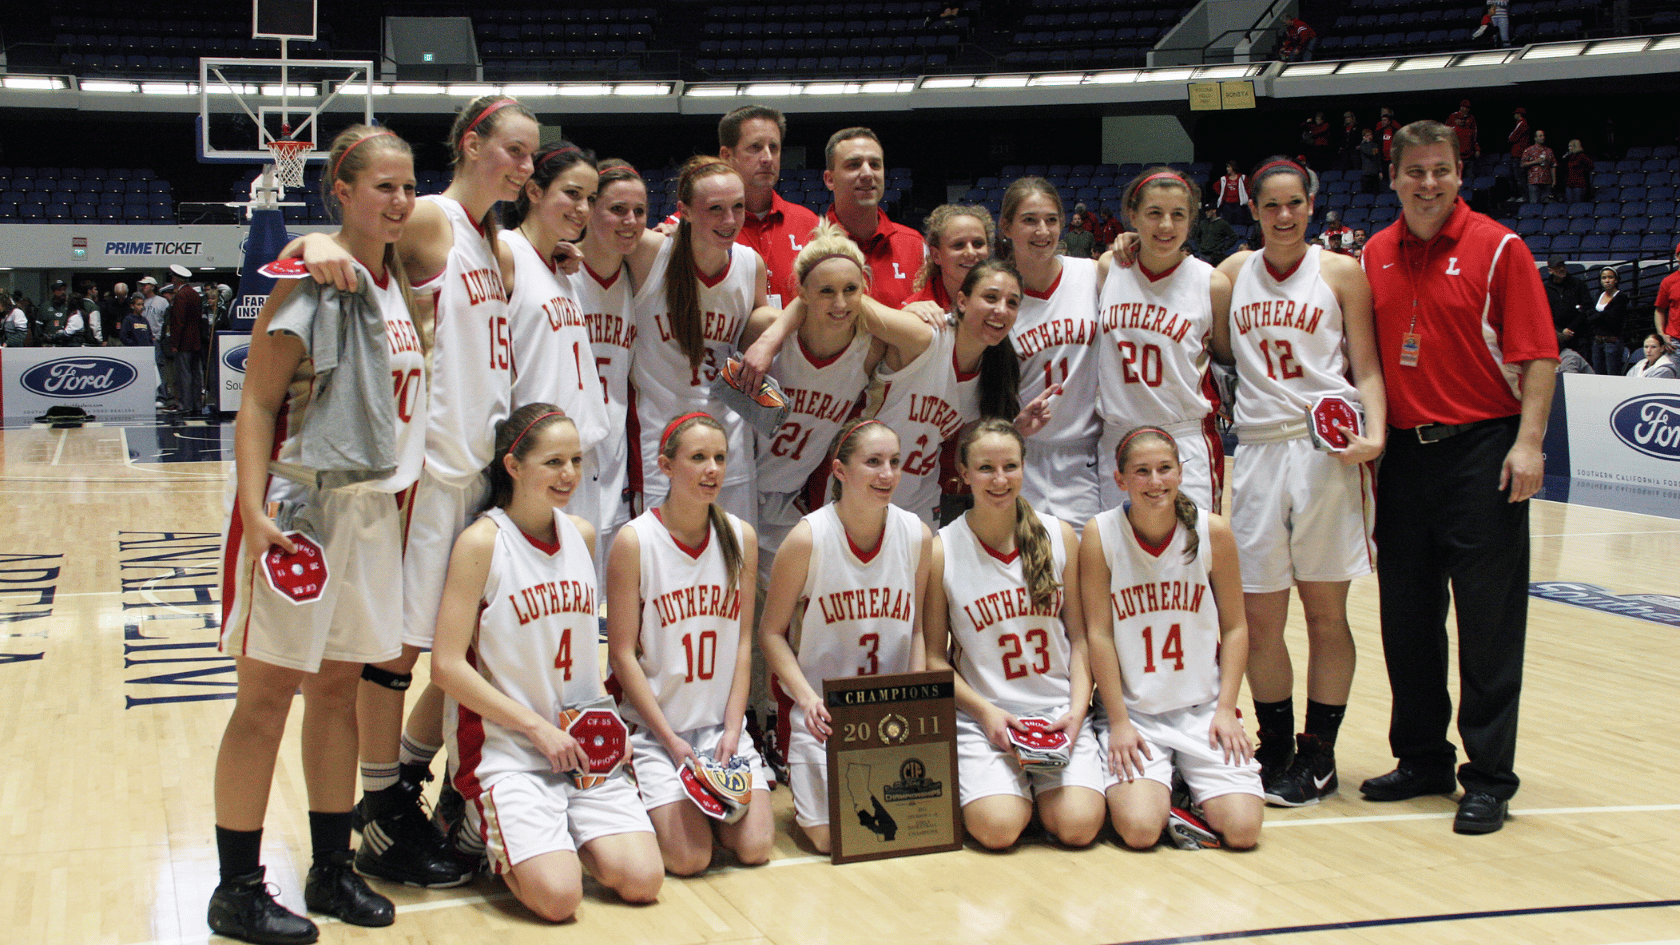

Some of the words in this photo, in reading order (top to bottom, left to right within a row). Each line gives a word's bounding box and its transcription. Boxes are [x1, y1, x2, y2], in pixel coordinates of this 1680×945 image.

[892, 262, 906, 279] L
[1445, 257, 1461, 276] L
[1102, 302, 1192, 344] LUTHERAN
[1233, 300, 1324, 336] LUTHERAN
[489, 316, 508, 370] 15
[1259, 339, 1304, 381] 12
[44, 362, 115, 392] Ford
[573, 341, 584, 391] 1
[1043, 356, 1069, 396] 11
[1117, 341, 1163, 388] 20
[770, 422, 814, 461] 21
[1616, 474, 1661, 485] CALIFORNIA
[653, 584, 740, 628] LUTHERAN
[819, 587, 912, 625] LUTHERAN
[1111, 580, 1206, 621] LUTHERAN
[554, 628, 573, 682] 4
[681, 631, 718, 683] 10
[857, 633, 880, 676] 3
[998, 628, 1051, 681] 23
[1141, 623, 1185, 673] 14
[845, 685, 939, 704] CHAMPIONS
[843, 722, 871, 742] 20
[918, 716, 941, 736] 11
